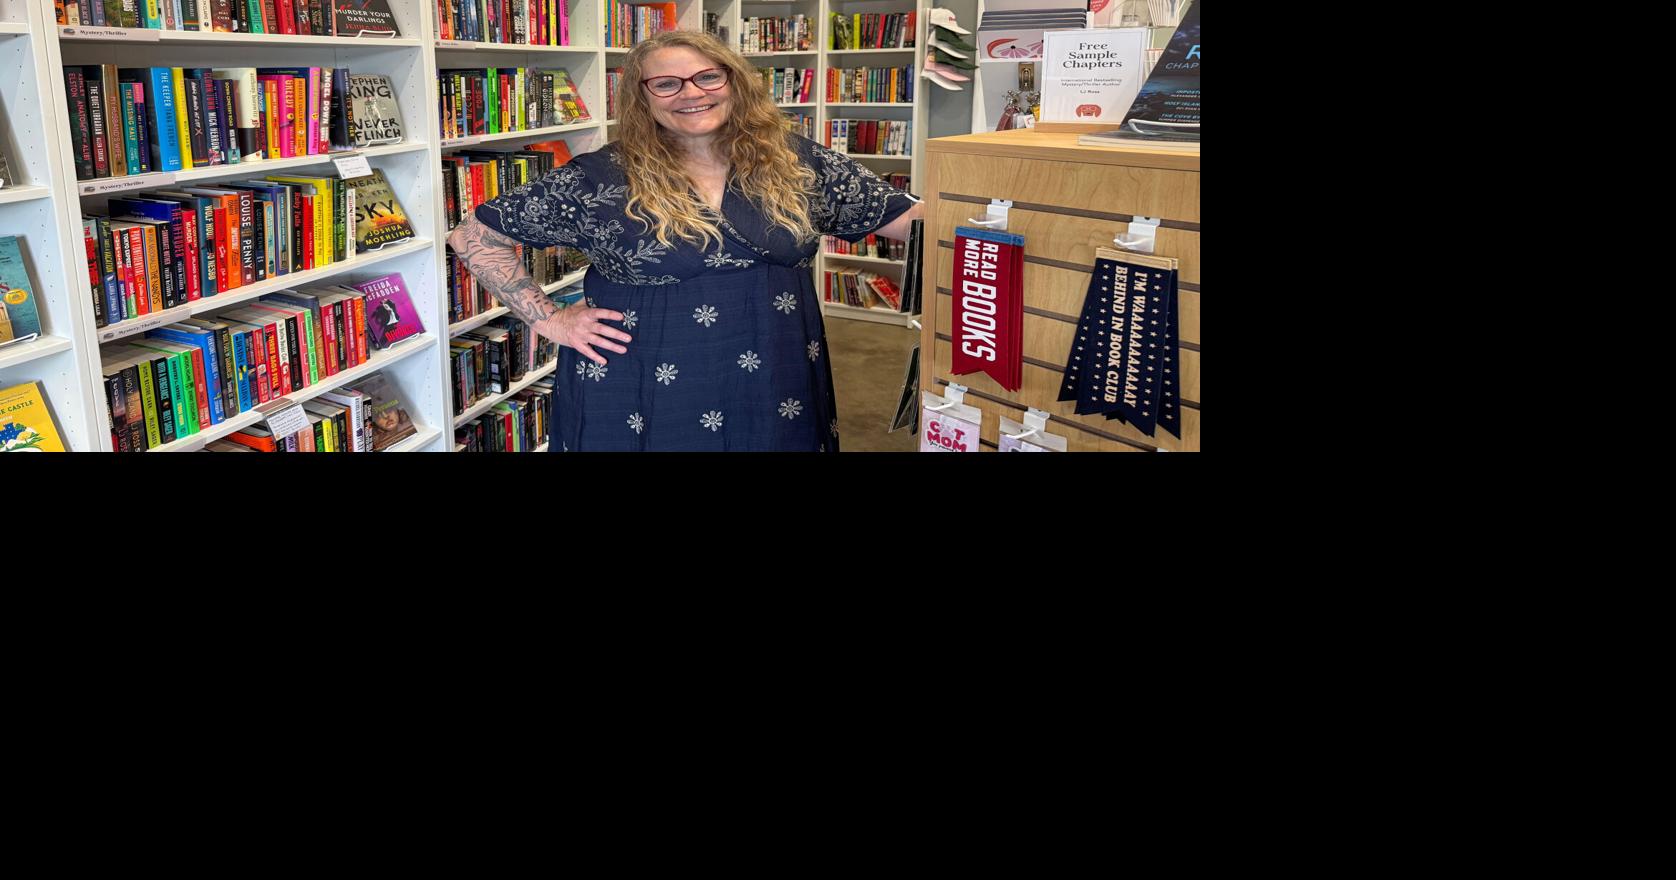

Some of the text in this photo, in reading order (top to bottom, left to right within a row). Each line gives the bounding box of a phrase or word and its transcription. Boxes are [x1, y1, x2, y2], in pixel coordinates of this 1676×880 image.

[80, 29, 127, 37] Mystery/Thriller
[1063, 60, 1122, 70] Chapters
[1069, 51, 1117, 60] Sample
[69, 73, 77, 97] ELSTON
[160, 72, 171, 107] THE KEEPER
[285, 80, 294, 99] GREEDY
[110, 96, 117, 105] MY
[322, 70, 331, 124] ANGEL DOWN
[77, 100, 86, 131] ANATOMY
[90, 86, 103, 135] THE QUIET LIBRARIAN
[125, 89, 136, 141] THE MISSING HALF
[110, 106, 120, 142] HUSBAND'S
[208, 112, 219, 150] MICK HERRON
[354, 117, 399, 130] NEVER
[355, 128, 401, 142] FLINCH
[167, 124, 175, 147] FRENCH
[100, 180, 144, 191] Mystery/Thriller
[240, 194, 251, 228] LOUISE
[293, 192, 301, 208] Ruby
[204, 205, 214, 240] WOLF HOUR
[255, 208, 264, 232] LOUISE
[369, 224, 403, 237] JOSHUA
[171, 207, 184, 258] THE INTRUDER
[185, 221, 193, 243] MURDER
[365, 229, 411, 246] MOEHLING
[103, 251, 114, 274] VACATION
[131, 230, 144, 277] PONY CONFIDENTIAL
[162, 250, 171, 265] MOTHER
[207, 252, 214, 260] JO
[242, 239, 253, 269] PENNY
[981, 242, 999, 281] READ
[150, 270, 161, 305] THE NANCYS
[364, 279, 391, 294] FREIDA
[1133, 270, 1148, 292] I'M
[962, 238, 997, 362] MORE BOOKS
[118, 319, 161, 335] Mystery/Thriller
[1103, 265, 1128, 403] BEHIND IN BOOK CLUB
[268, 335, 279, 388] THREE BAGS FULL
[125, 377, 136, 419] HOLY ISLAND
[143, 379, 151, 397] BEFORE
[158, 376, 170, 401] VENGEANCE
[8, 399, 35, 412] CASTLE
[162, 409, 173, 436] RILEY SAGER
[130, 421, 140, 448] LJ ROSS
[150, 430, 158, 446] SAGER
[927, 430, 967, 452] MOM
